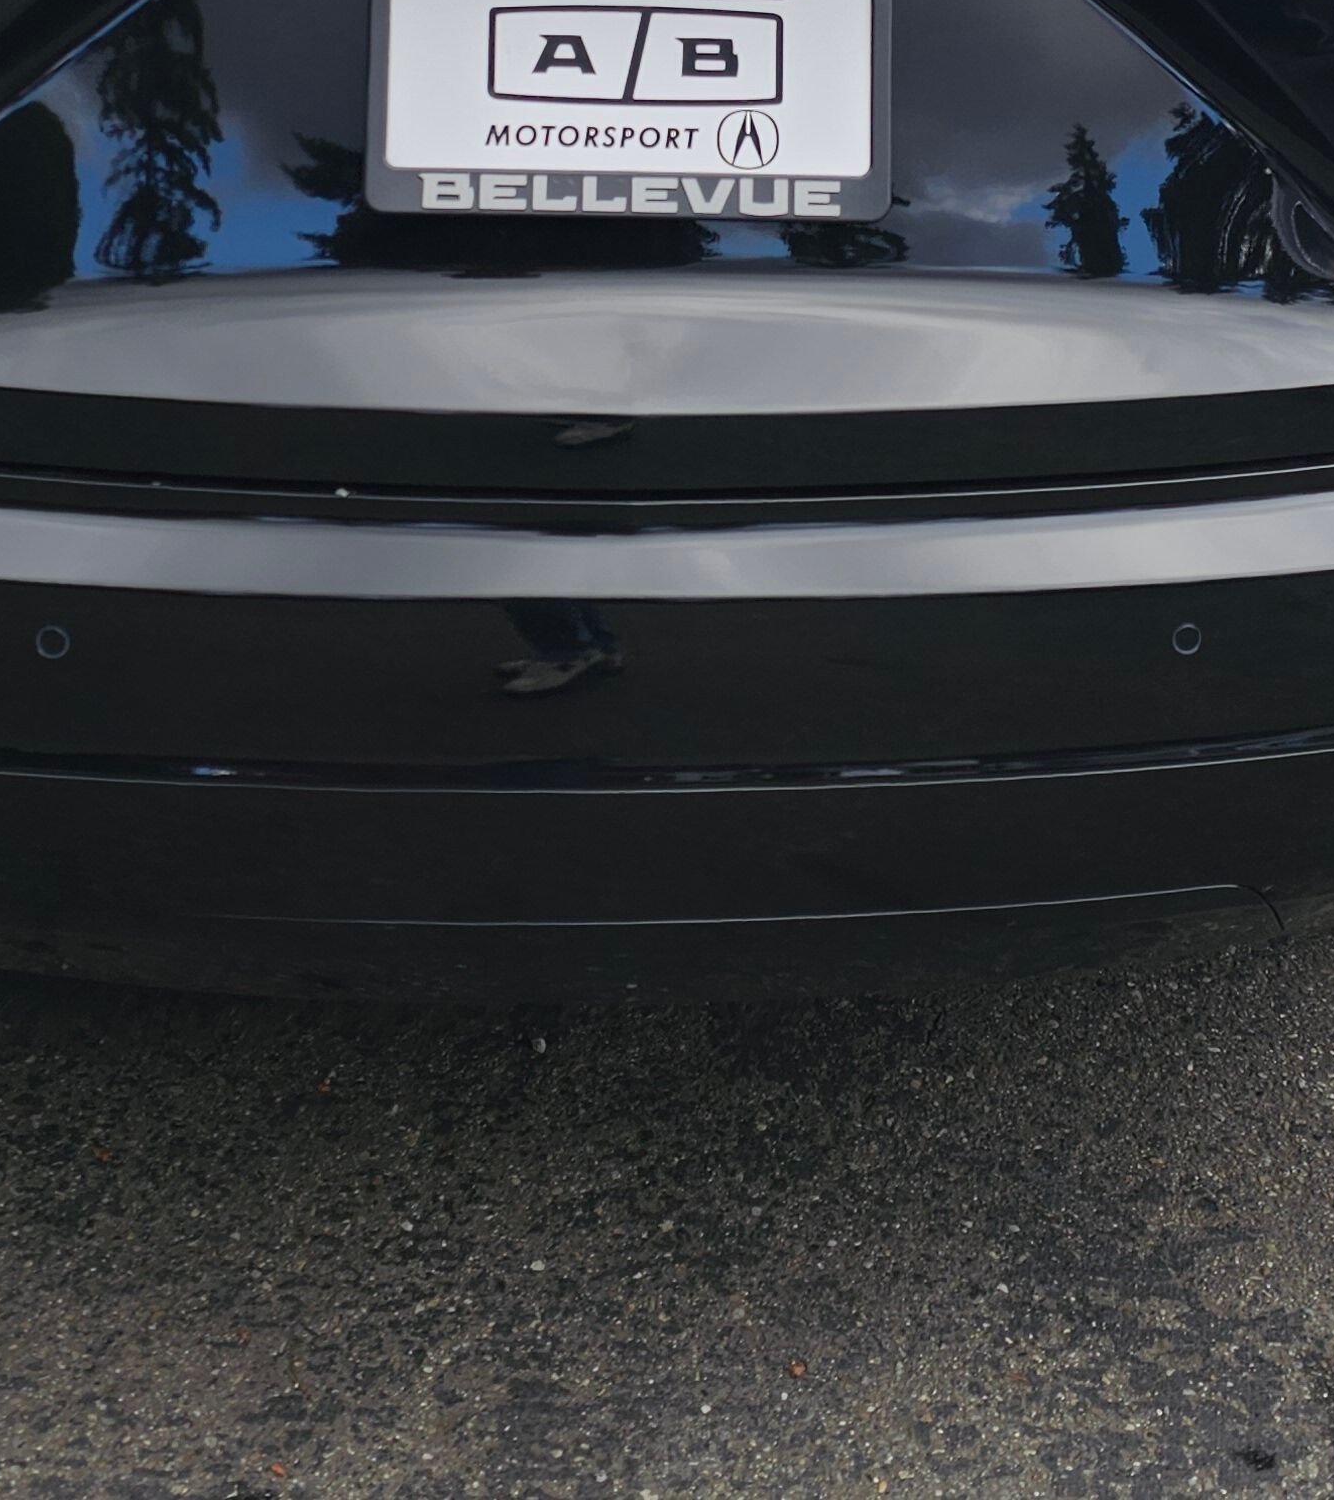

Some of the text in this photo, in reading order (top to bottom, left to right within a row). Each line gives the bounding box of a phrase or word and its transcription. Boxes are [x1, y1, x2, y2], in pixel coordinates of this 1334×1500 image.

[532, 35, 738, 77] A B
[485, 124, 700, 150] MOTORSPORT
[418, 172, 842, 218] BELLEVUE
